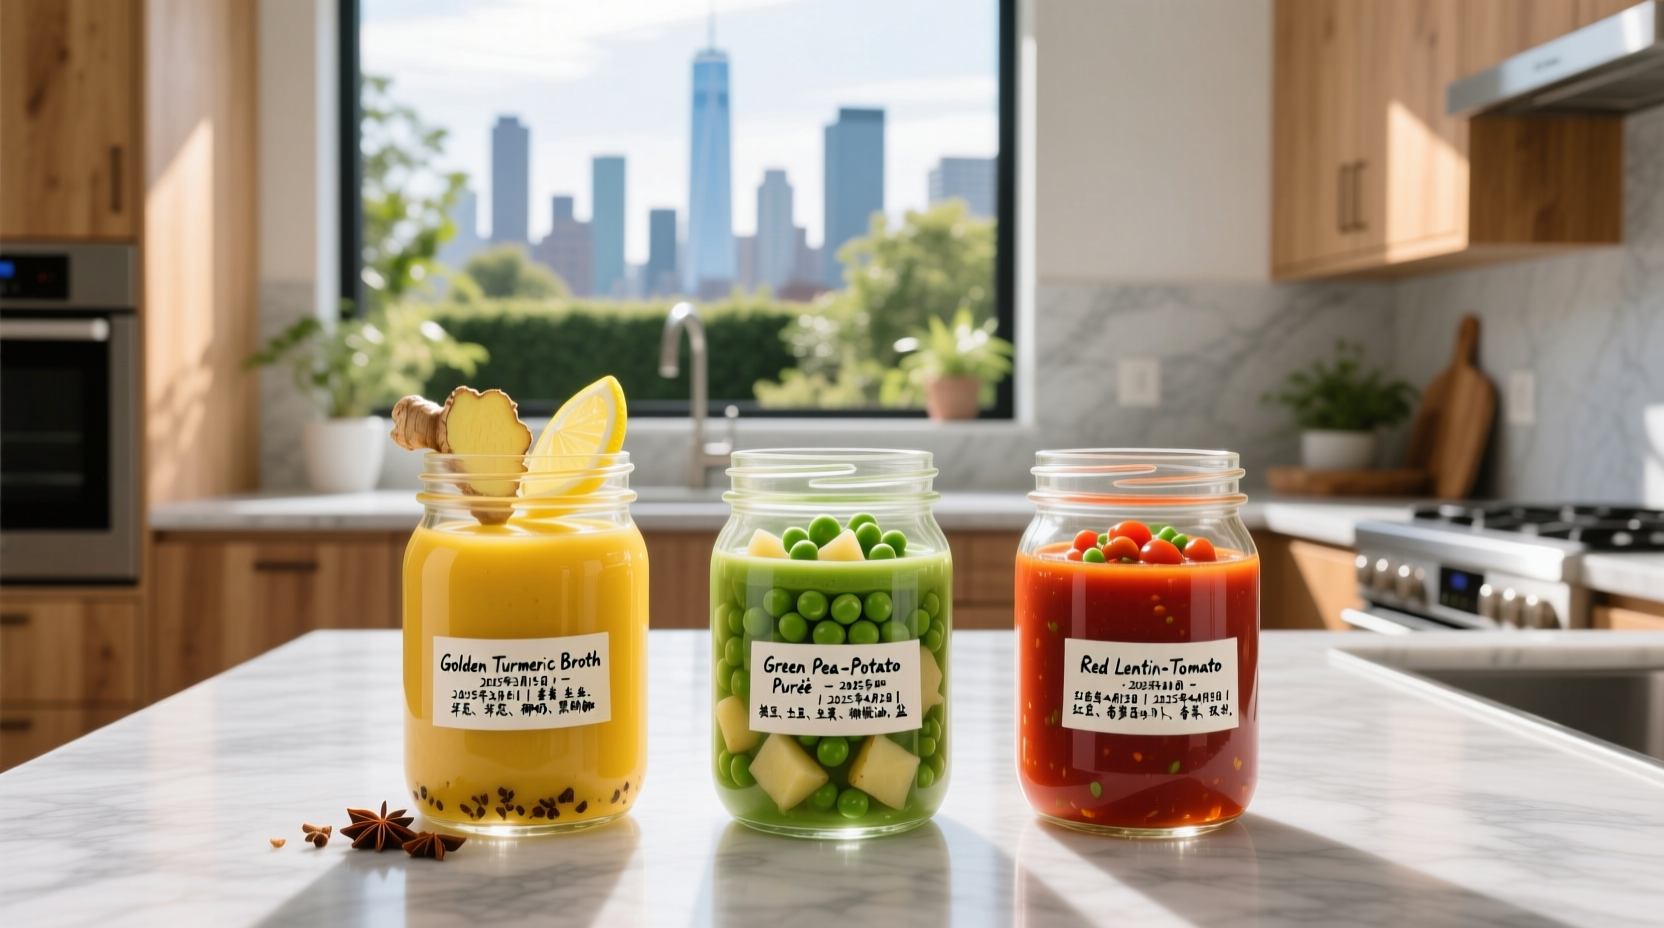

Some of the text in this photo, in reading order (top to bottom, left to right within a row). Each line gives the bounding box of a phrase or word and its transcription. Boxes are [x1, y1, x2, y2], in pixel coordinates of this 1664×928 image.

[441, 650, 601, 673] Golden Turmeric Broth
[764, 656, 901, 675] Green Pea-Potato
[1080, 655, 1109, 674] Red
